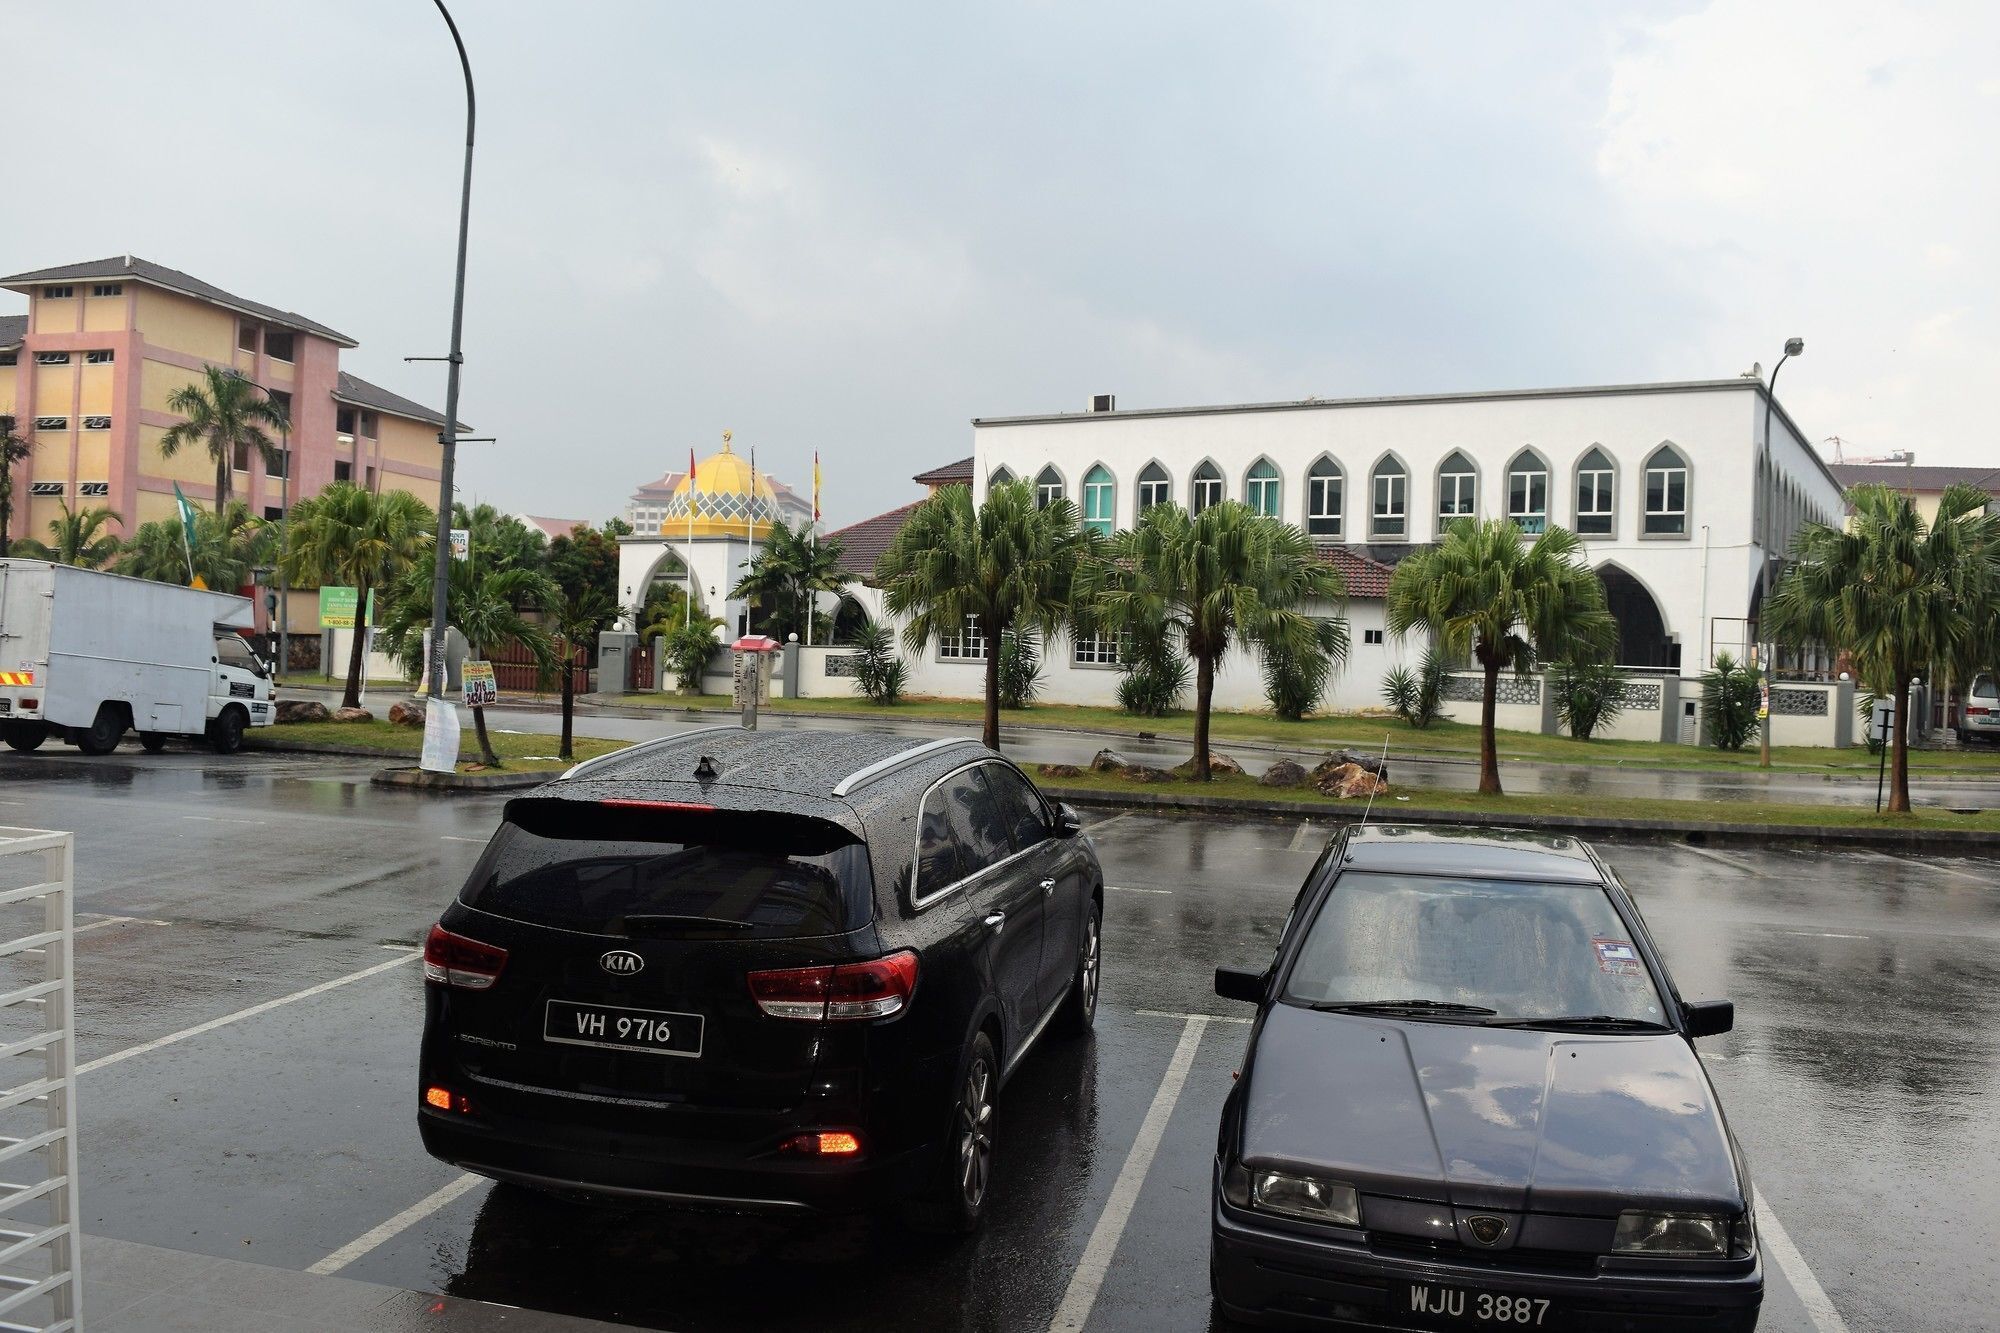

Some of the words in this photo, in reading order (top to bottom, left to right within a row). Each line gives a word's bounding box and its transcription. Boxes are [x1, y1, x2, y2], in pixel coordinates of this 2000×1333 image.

[474, 681, 487, 692] 016
[466, 690, 482, 705] 2424
[484, 690, 496, 703] 022
[606, 955, 636, 971] KIA
[576, 1012, 606, 1036] VH
[616, 1017, 671, 1042] 9716
[460, 1033, 517, 1051] SORENTO
[1411, 1285, 1465, 1316] WJU
[1476, 1293, 1551, 1325] 3887
